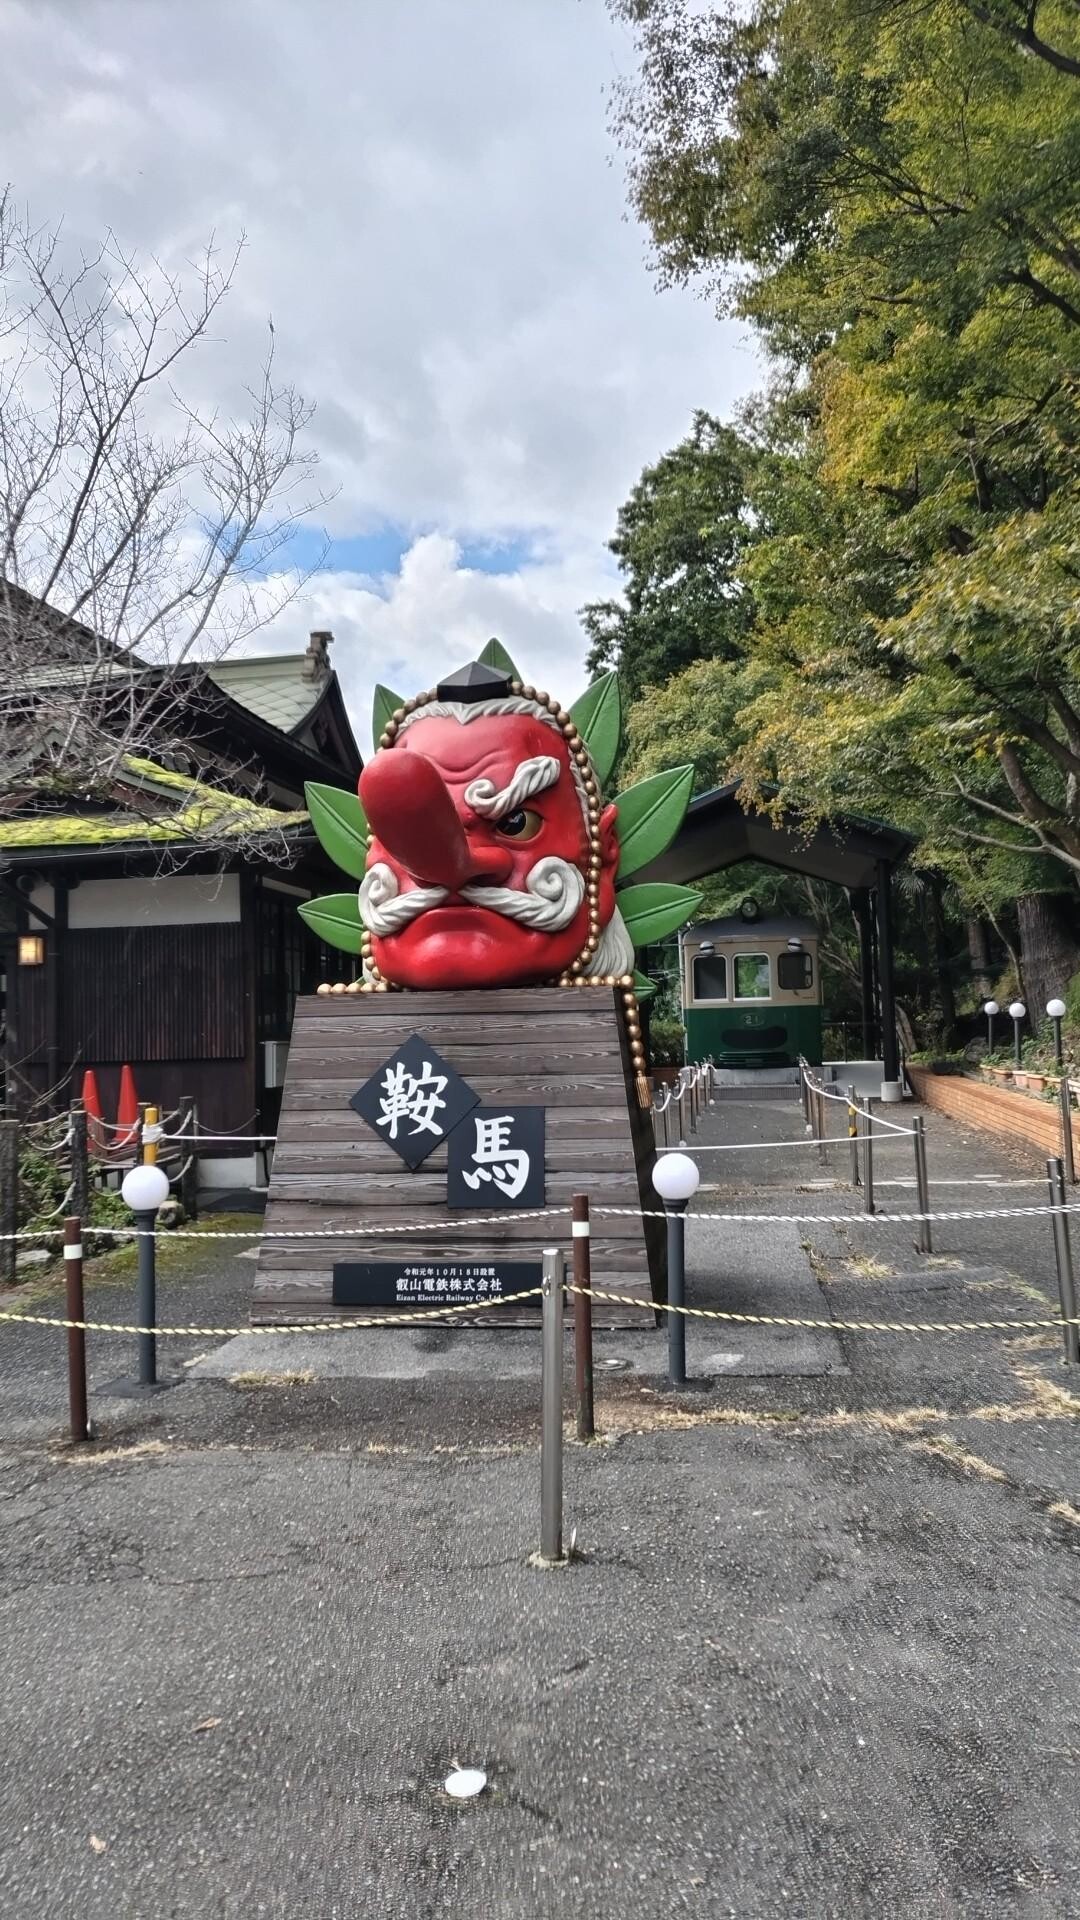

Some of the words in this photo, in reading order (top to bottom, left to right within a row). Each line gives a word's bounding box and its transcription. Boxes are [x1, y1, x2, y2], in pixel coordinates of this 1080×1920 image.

[376, 1061, 448, 1139] 鞍
[462, 1115, 530, 1200] 馬
[396, 1277, 502, 1291] 叡山電鉄株式会社
[446, 1294, 474, 1302] Railway
